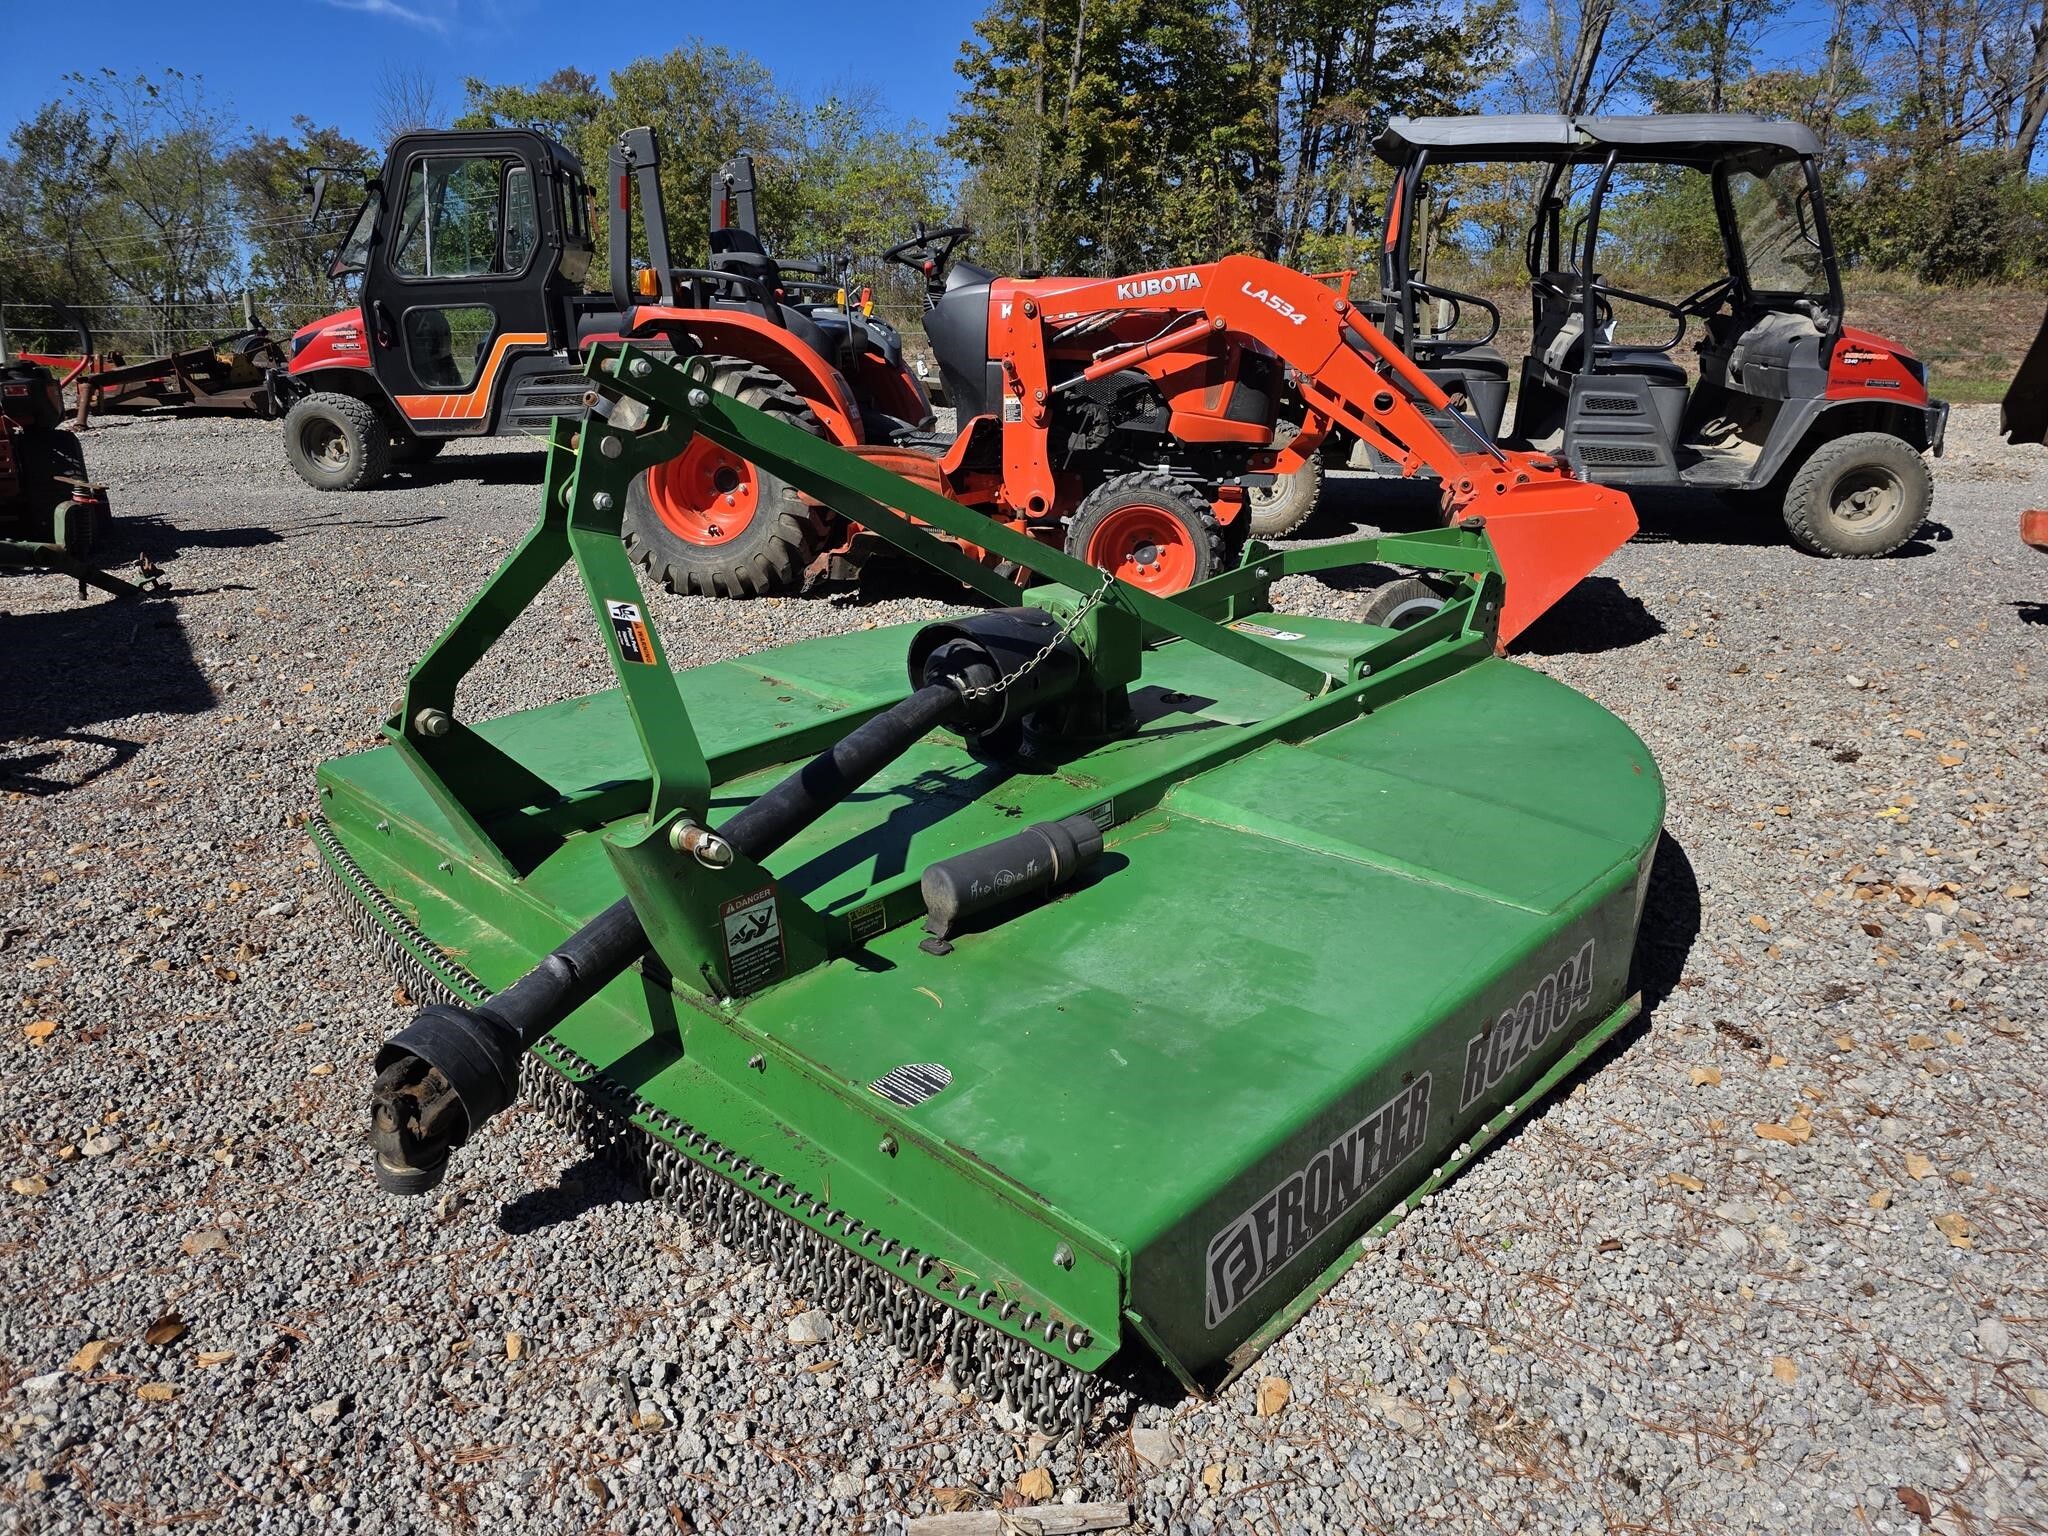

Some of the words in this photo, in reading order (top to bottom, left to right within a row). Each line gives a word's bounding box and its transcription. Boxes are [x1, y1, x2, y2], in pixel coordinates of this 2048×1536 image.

[1117, 272, 1201, 300] KUBOTA
[1241, 281, 1307, 325] LA534
[637, 629, 653, 663] WARNING
[735, 888, 771, 910] DANGER
[1459, 938, 1595, 1113] RC2084
[1252, 1070, 1433, 1270] FRONTIER
[1265, 1139, 1418, 1276] EQUIPMENT
